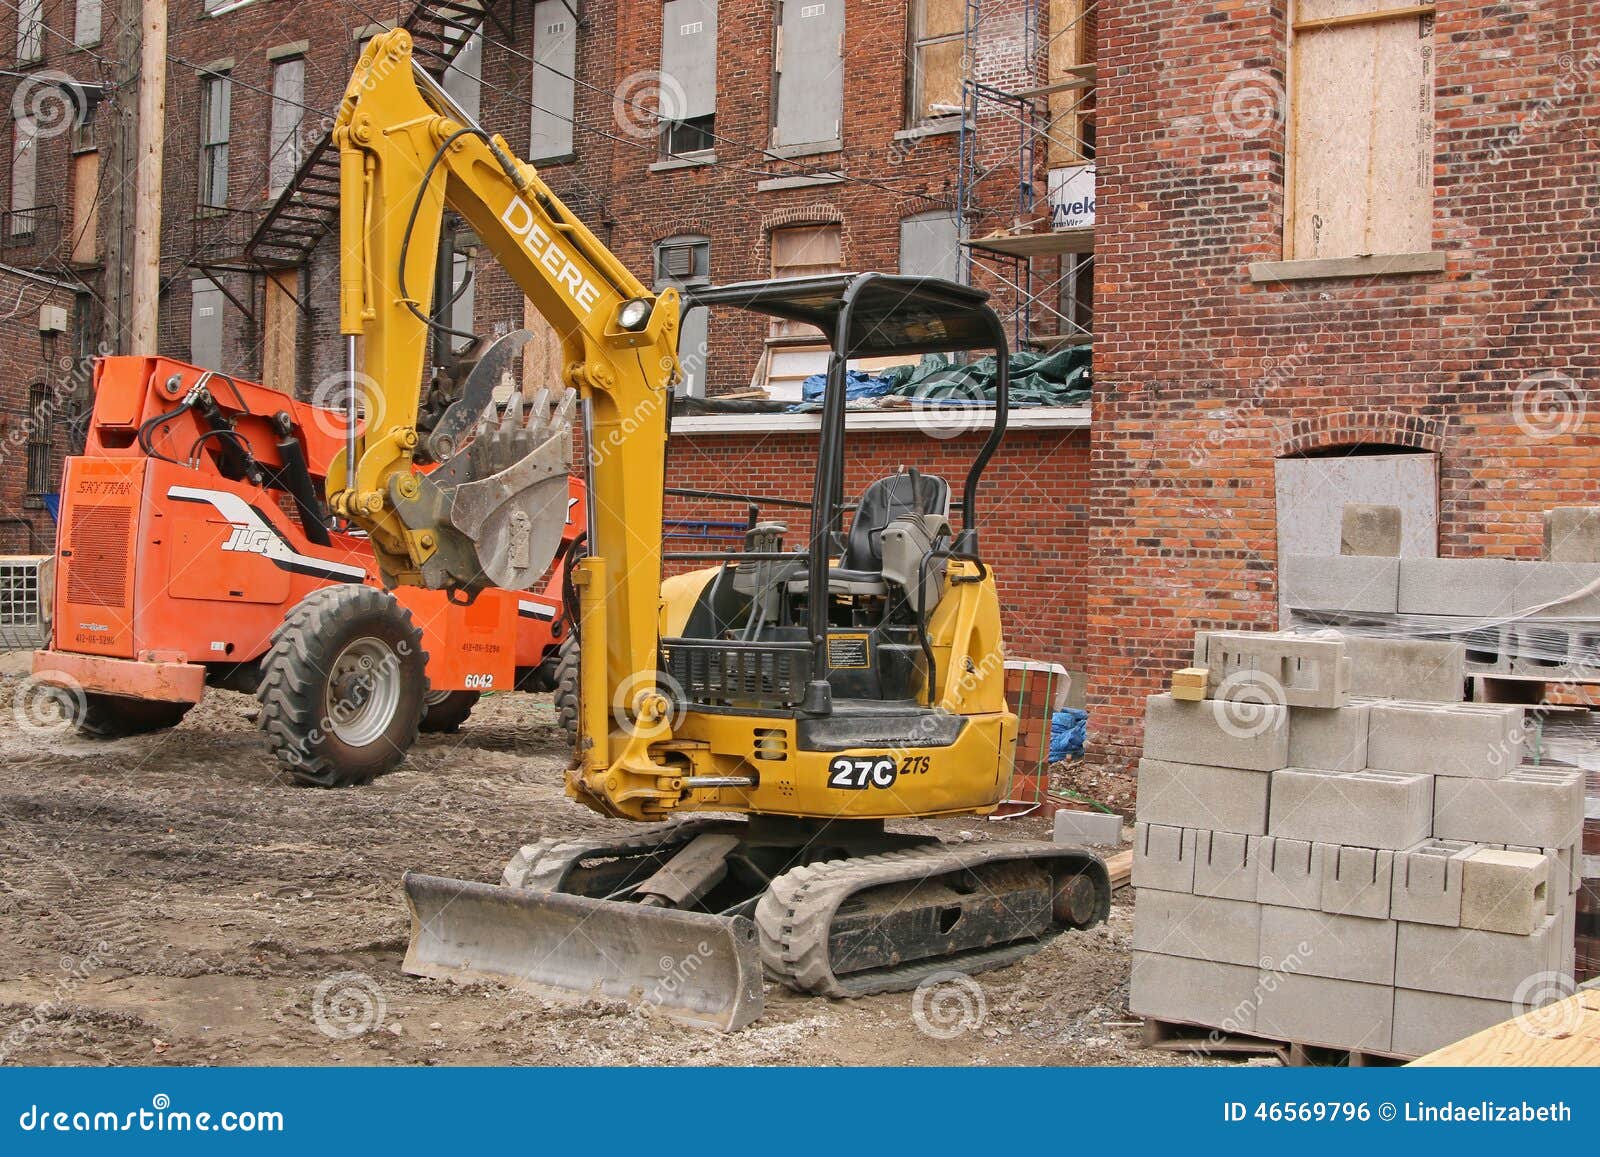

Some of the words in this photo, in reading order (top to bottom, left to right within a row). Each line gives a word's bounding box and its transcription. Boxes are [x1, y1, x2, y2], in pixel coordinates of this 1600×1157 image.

[1050, 196, 1096, 222] yvek
[501, 194, 601, 313] DEERE
[221, 527, 272, 554] JLG
[465, 674, 494, 689] 6042
[831, 759, 894, 787] 27C
[900, 756, 930, 775] ZTS
